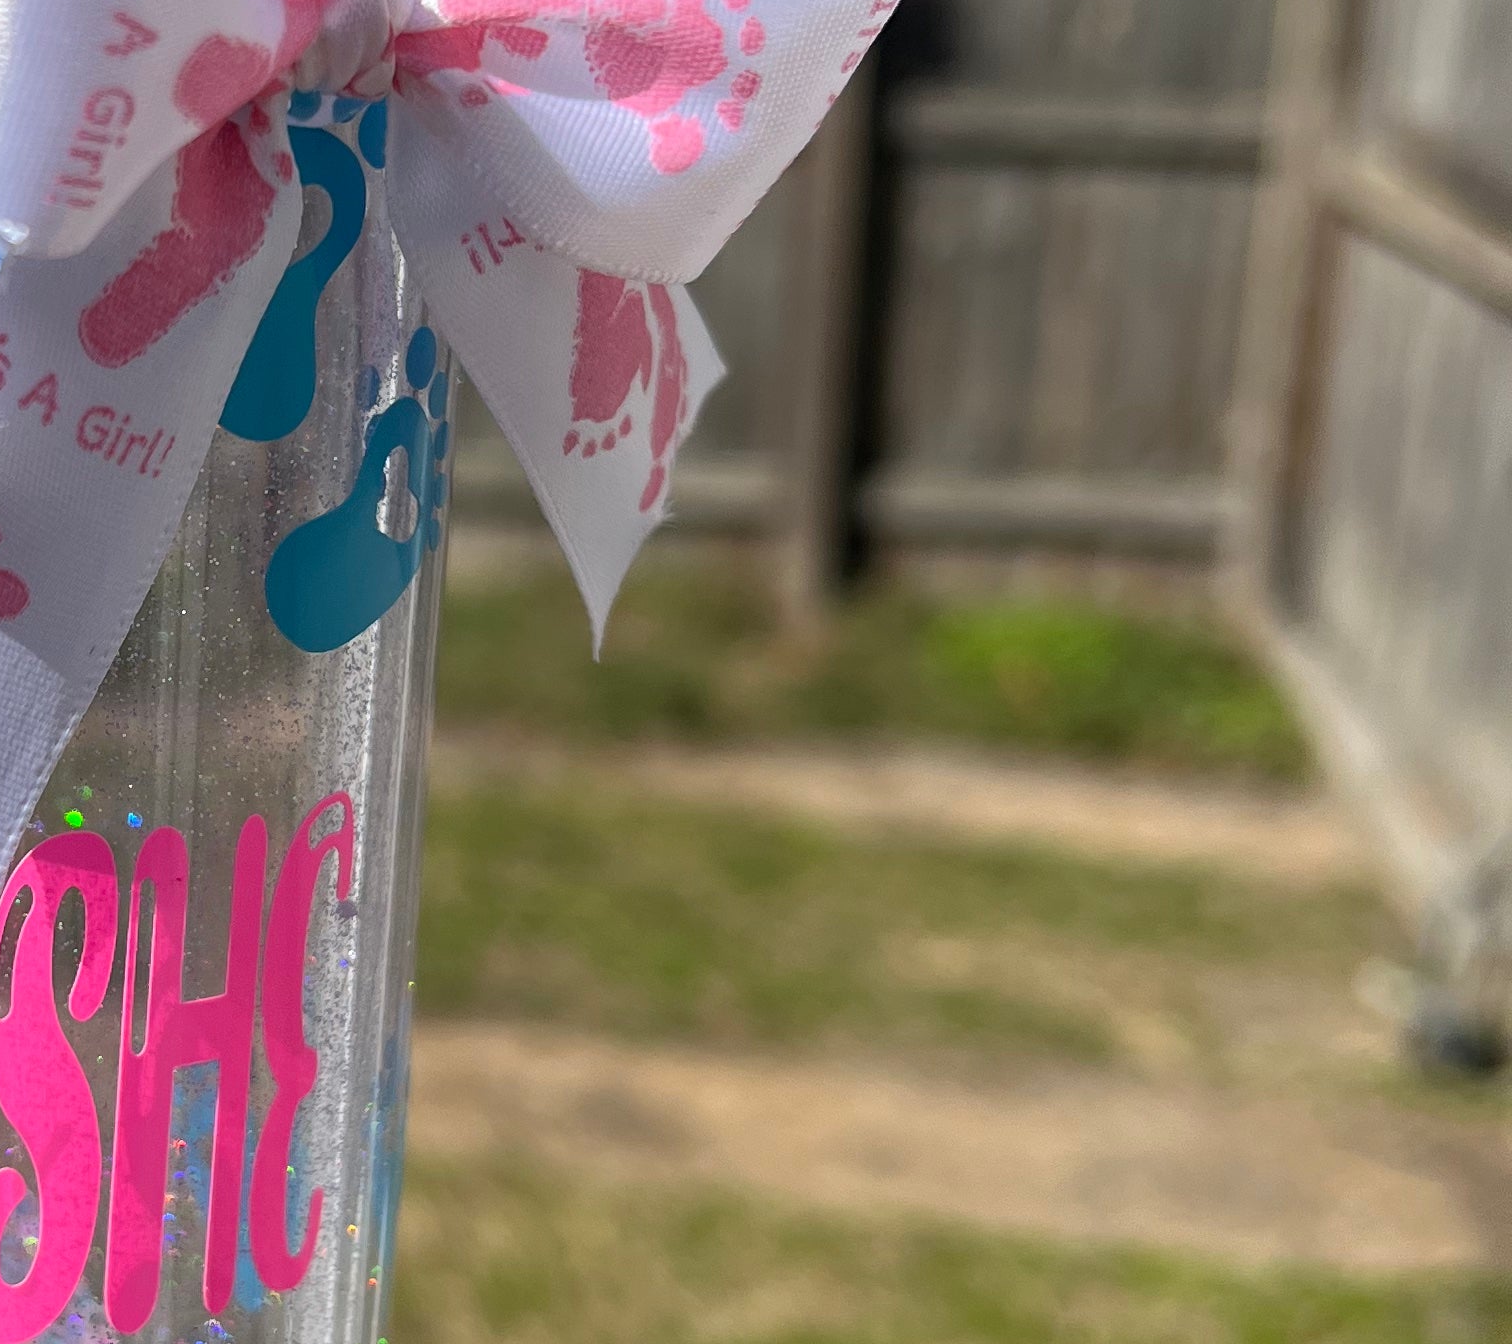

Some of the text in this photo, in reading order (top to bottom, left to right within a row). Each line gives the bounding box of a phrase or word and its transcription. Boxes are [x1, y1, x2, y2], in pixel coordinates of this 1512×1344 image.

[102, 9, 159, 58] A
[44, 86, 136, 209] Girl!
[17, 372, 59, 427] A
[75, 406, 176, 479] Girl!
